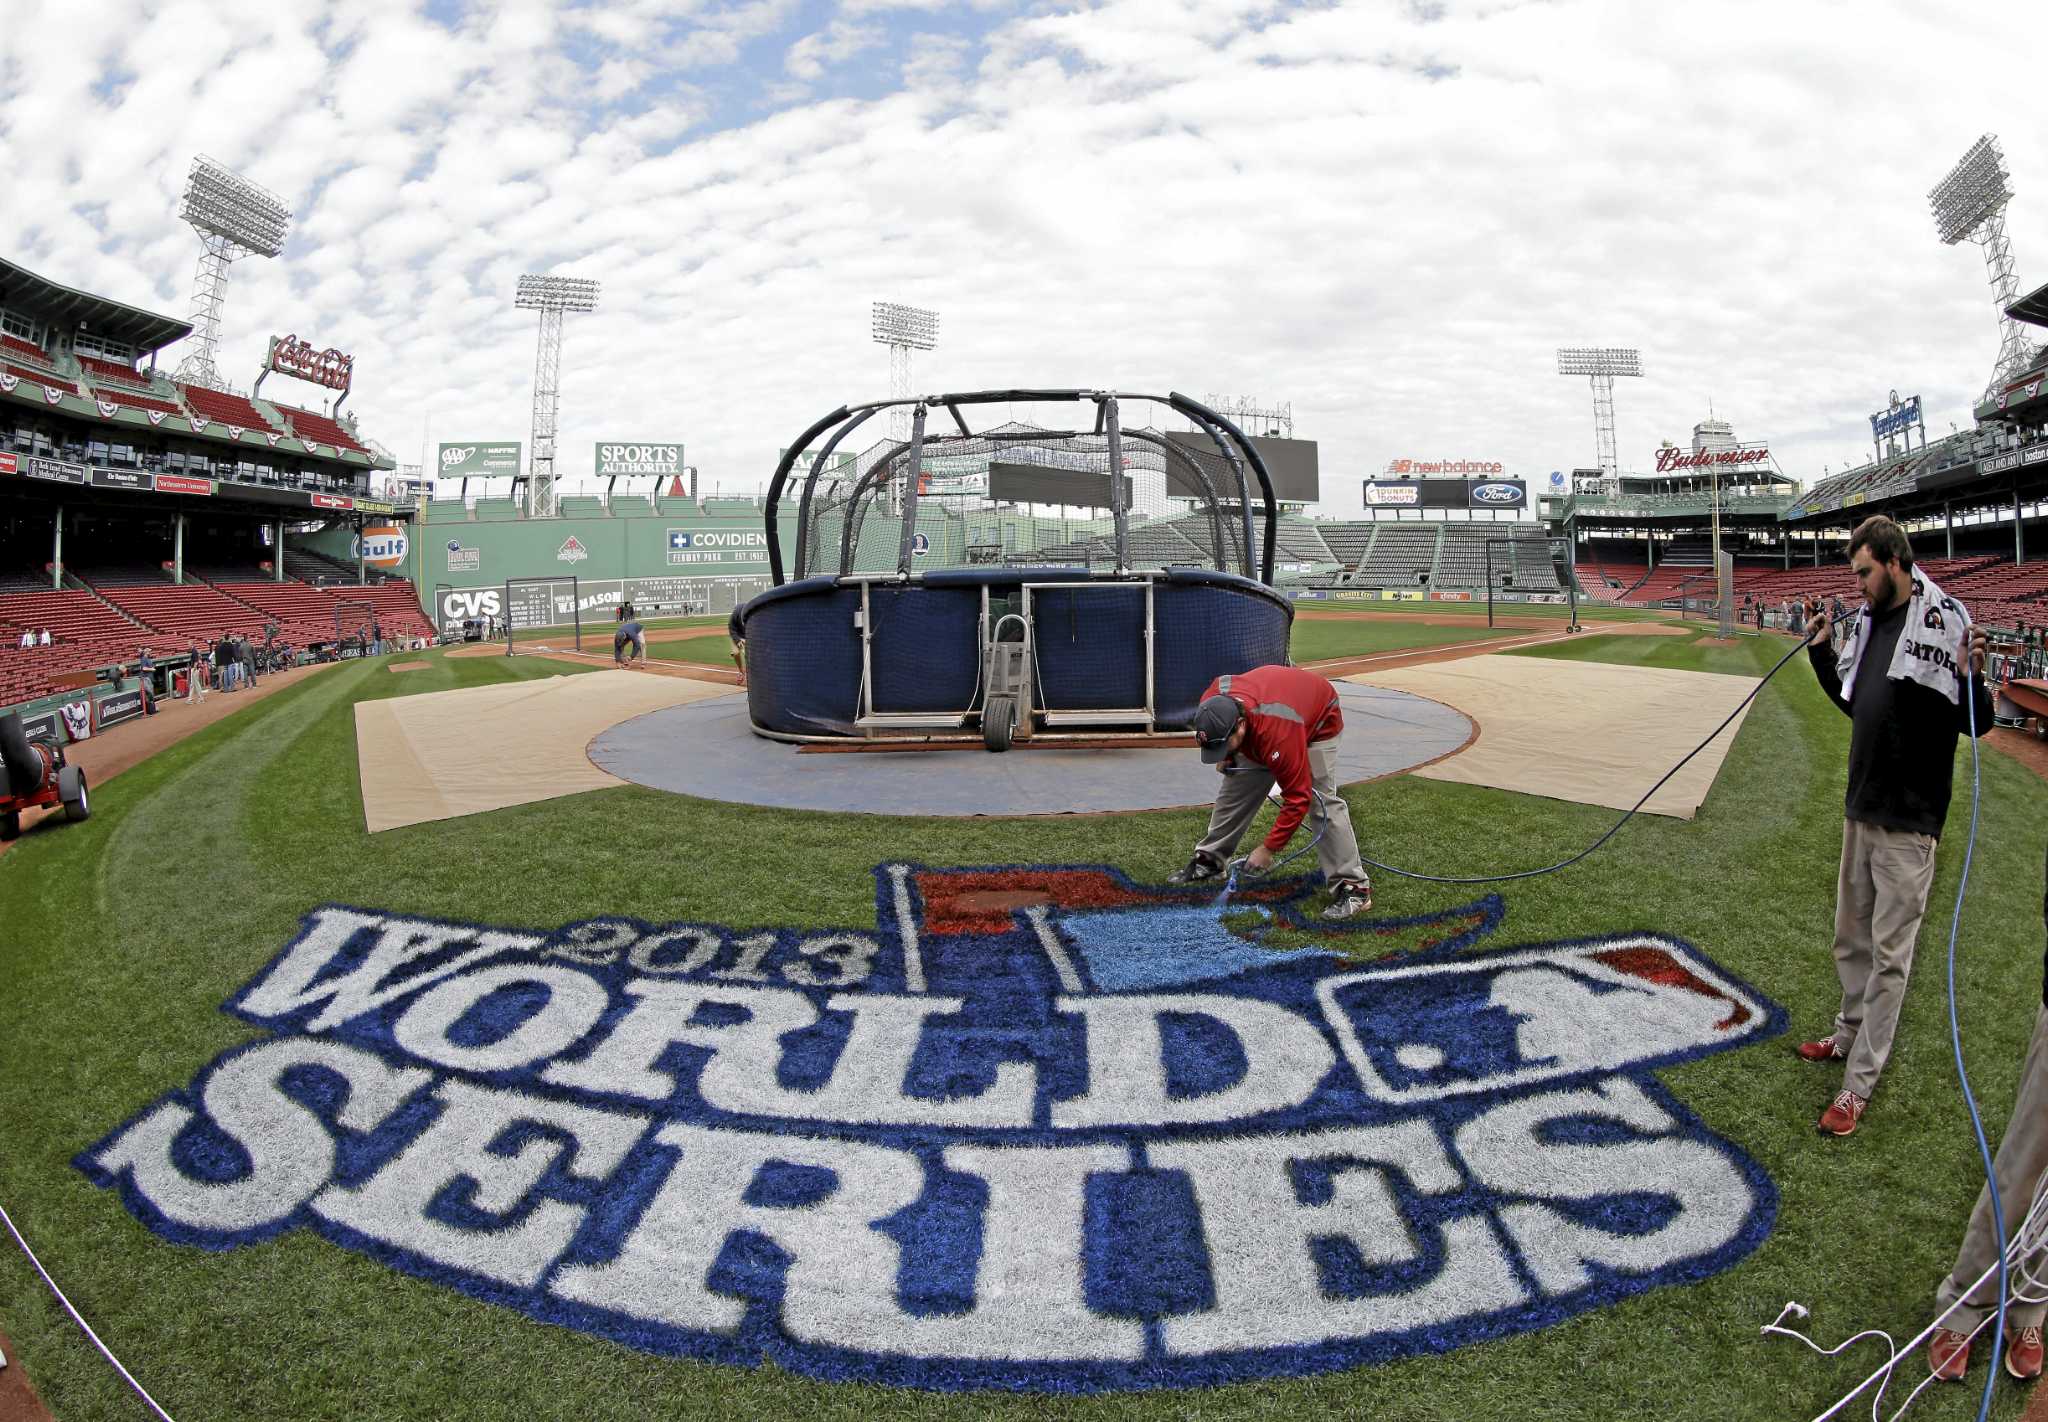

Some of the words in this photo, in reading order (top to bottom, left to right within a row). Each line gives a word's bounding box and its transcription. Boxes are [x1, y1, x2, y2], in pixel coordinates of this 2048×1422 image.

[601, 446, 678, 462] SPORTS
[1655, 447, 1768, 473] Budweiser
[1443, 459, 1502, 473] balance
[1483, 486, 1513, 500] Ford
[357, 540, 404, 556] Gulf
[693, 533, 767, 546] COVIDIEN
[444, 591, 501, 618] CVS
[579, 592, 622, 611] MASON
[1904, 639, 1959, 679] GATOR
[547, 920, 880, 986] 2013
[237, 908, 1335, 1131] WORLD
[97, 1037, 1756, 1361] SERIES
